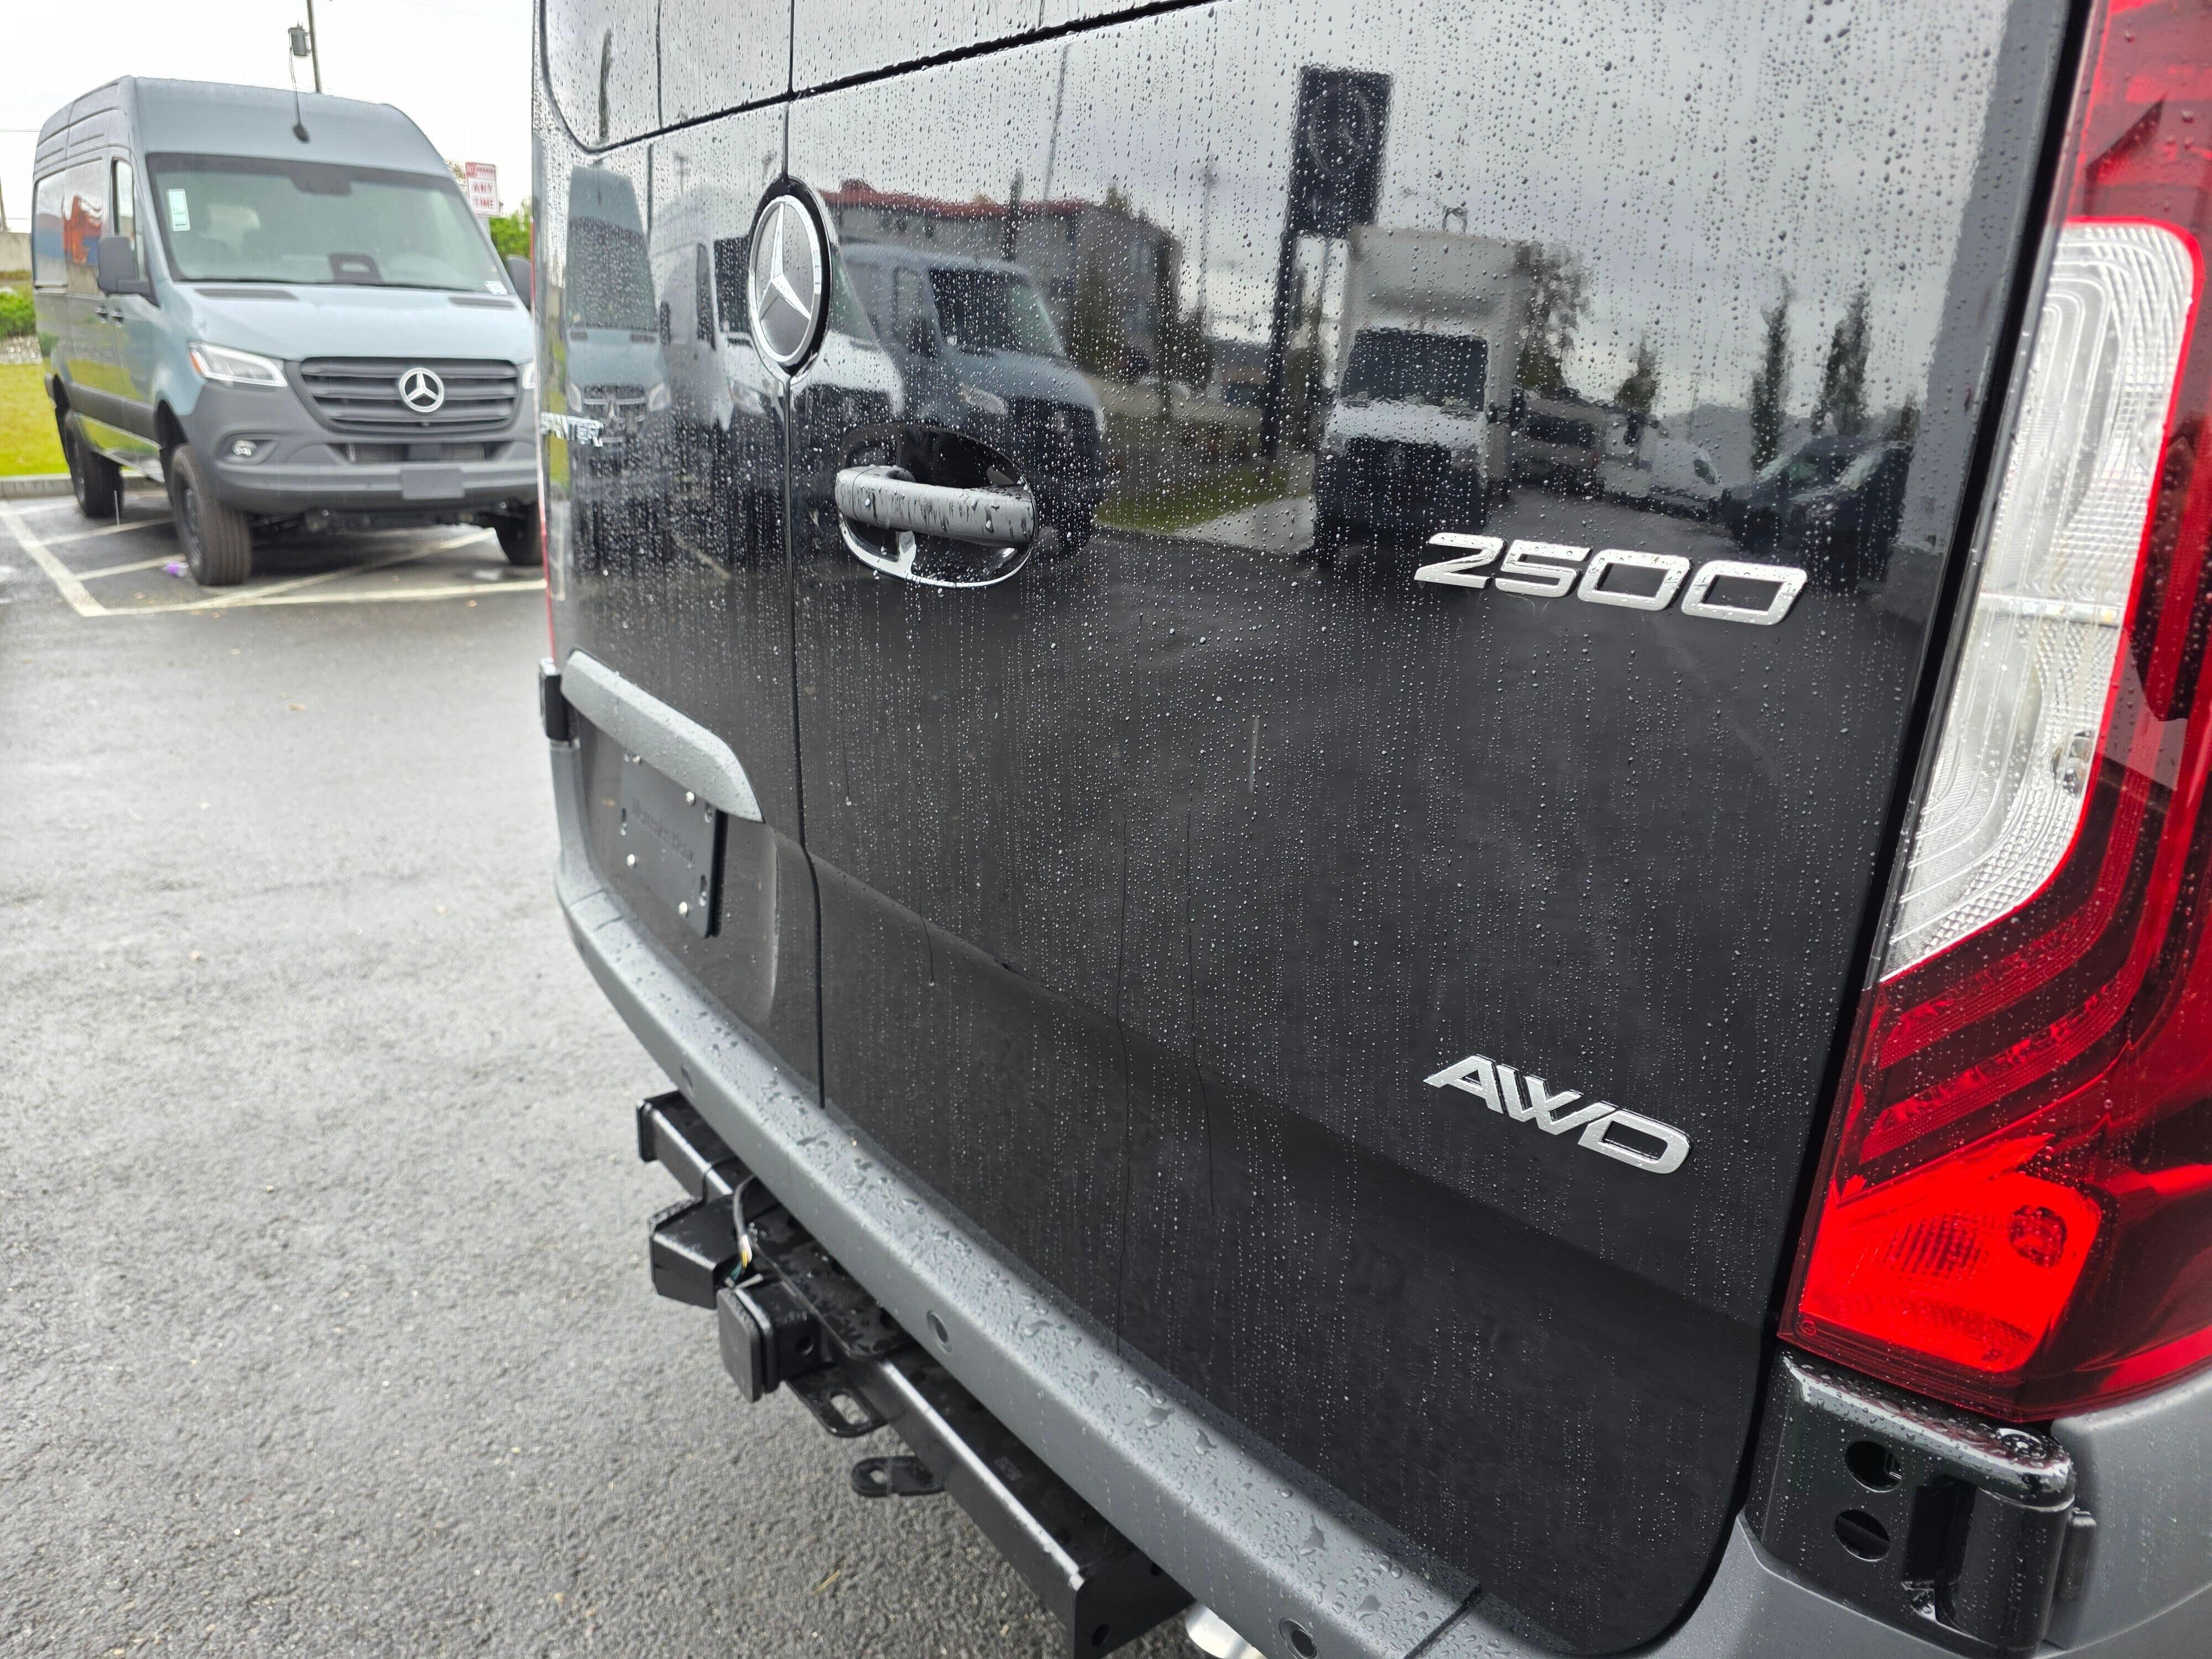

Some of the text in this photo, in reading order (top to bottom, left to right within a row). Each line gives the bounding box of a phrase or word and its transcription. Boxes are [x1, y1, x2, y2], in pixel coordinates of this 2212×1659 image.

[473, 181, 493, 193] ANY
[474, 197, 493, 208] TIME
[1414, 532, 1807, 625] 2500
[1423, 1054, 1691, 1173] AWD
